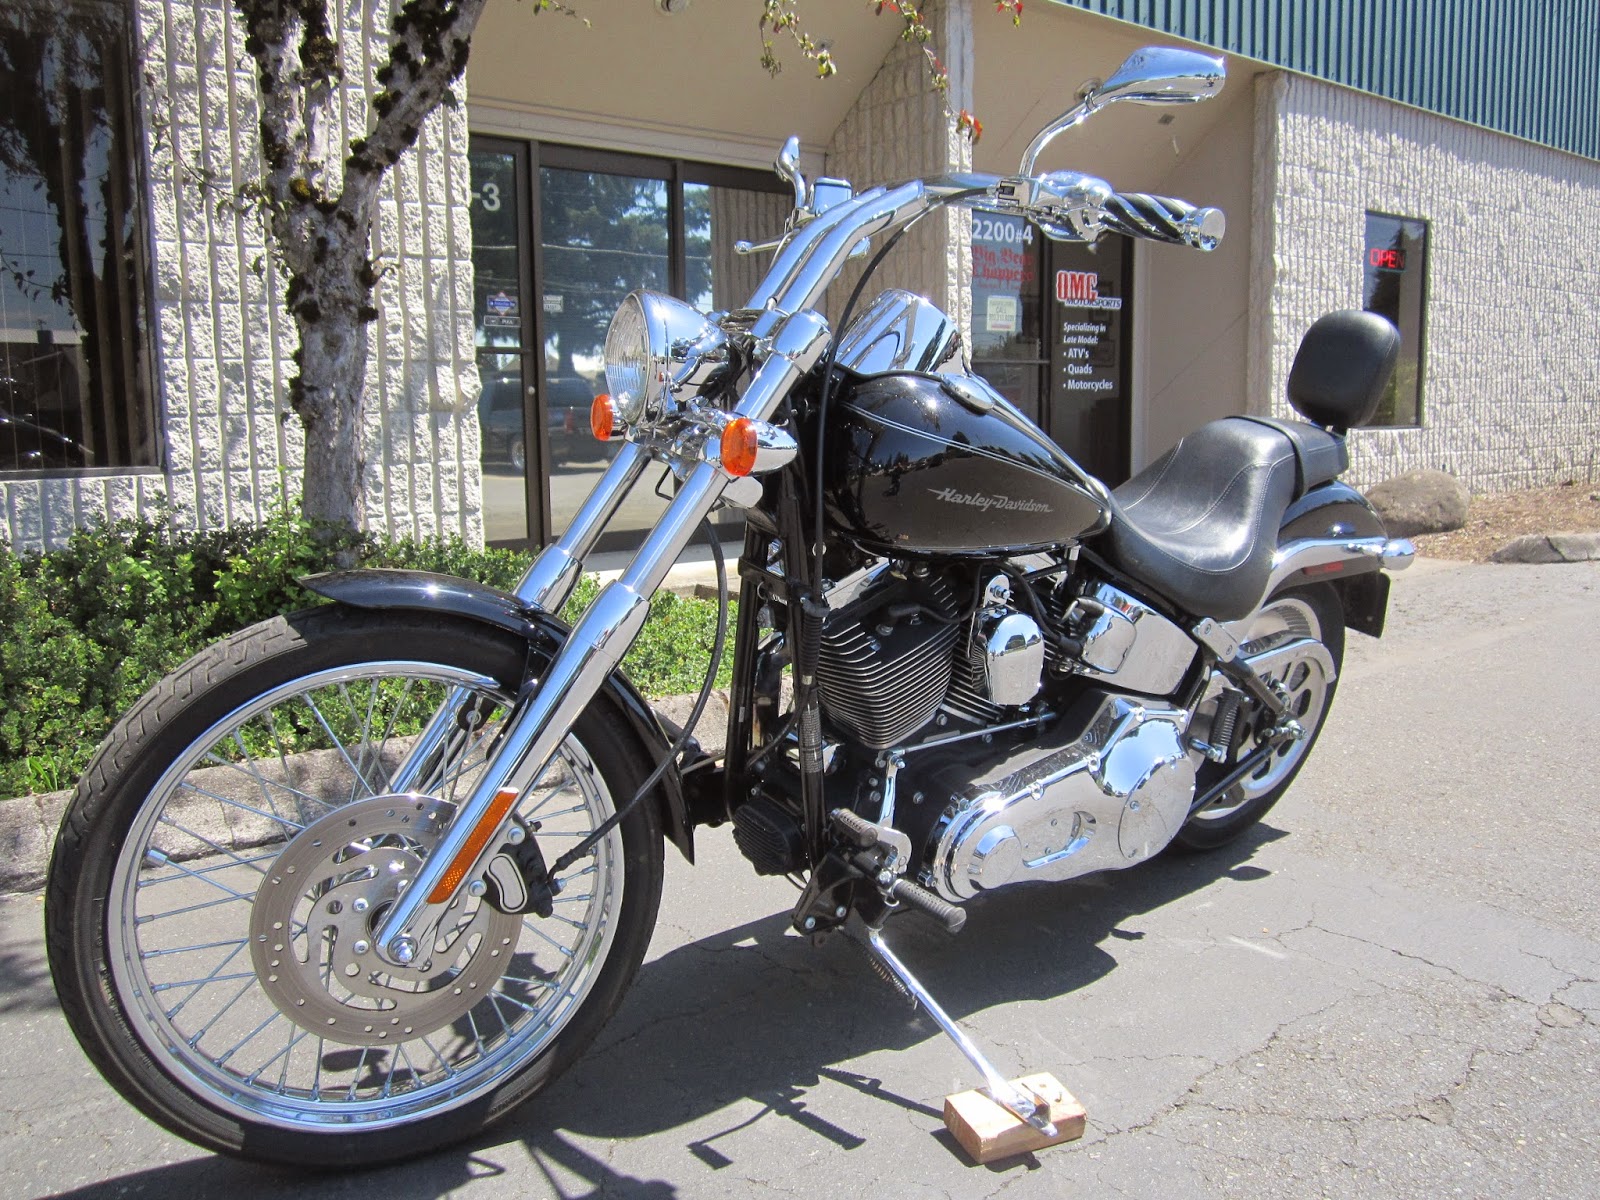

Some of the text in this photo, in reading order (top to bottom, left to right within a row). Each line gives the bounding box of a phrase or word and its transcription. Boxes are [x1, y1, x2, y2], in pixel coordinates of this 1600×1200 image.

[1370, 248, 1405, 269] OPEN
[1063, 322, 1106, 335] Specializing in
[1063, 335, 1077, 344] Late
[1068, 348, 1089, 359] ATV's
[1068, 363, 1093, 375] Quads
[1067, 379, 1113, 392] Motorcycles
[927, 487, 1054, 512] Harley-Davidson
